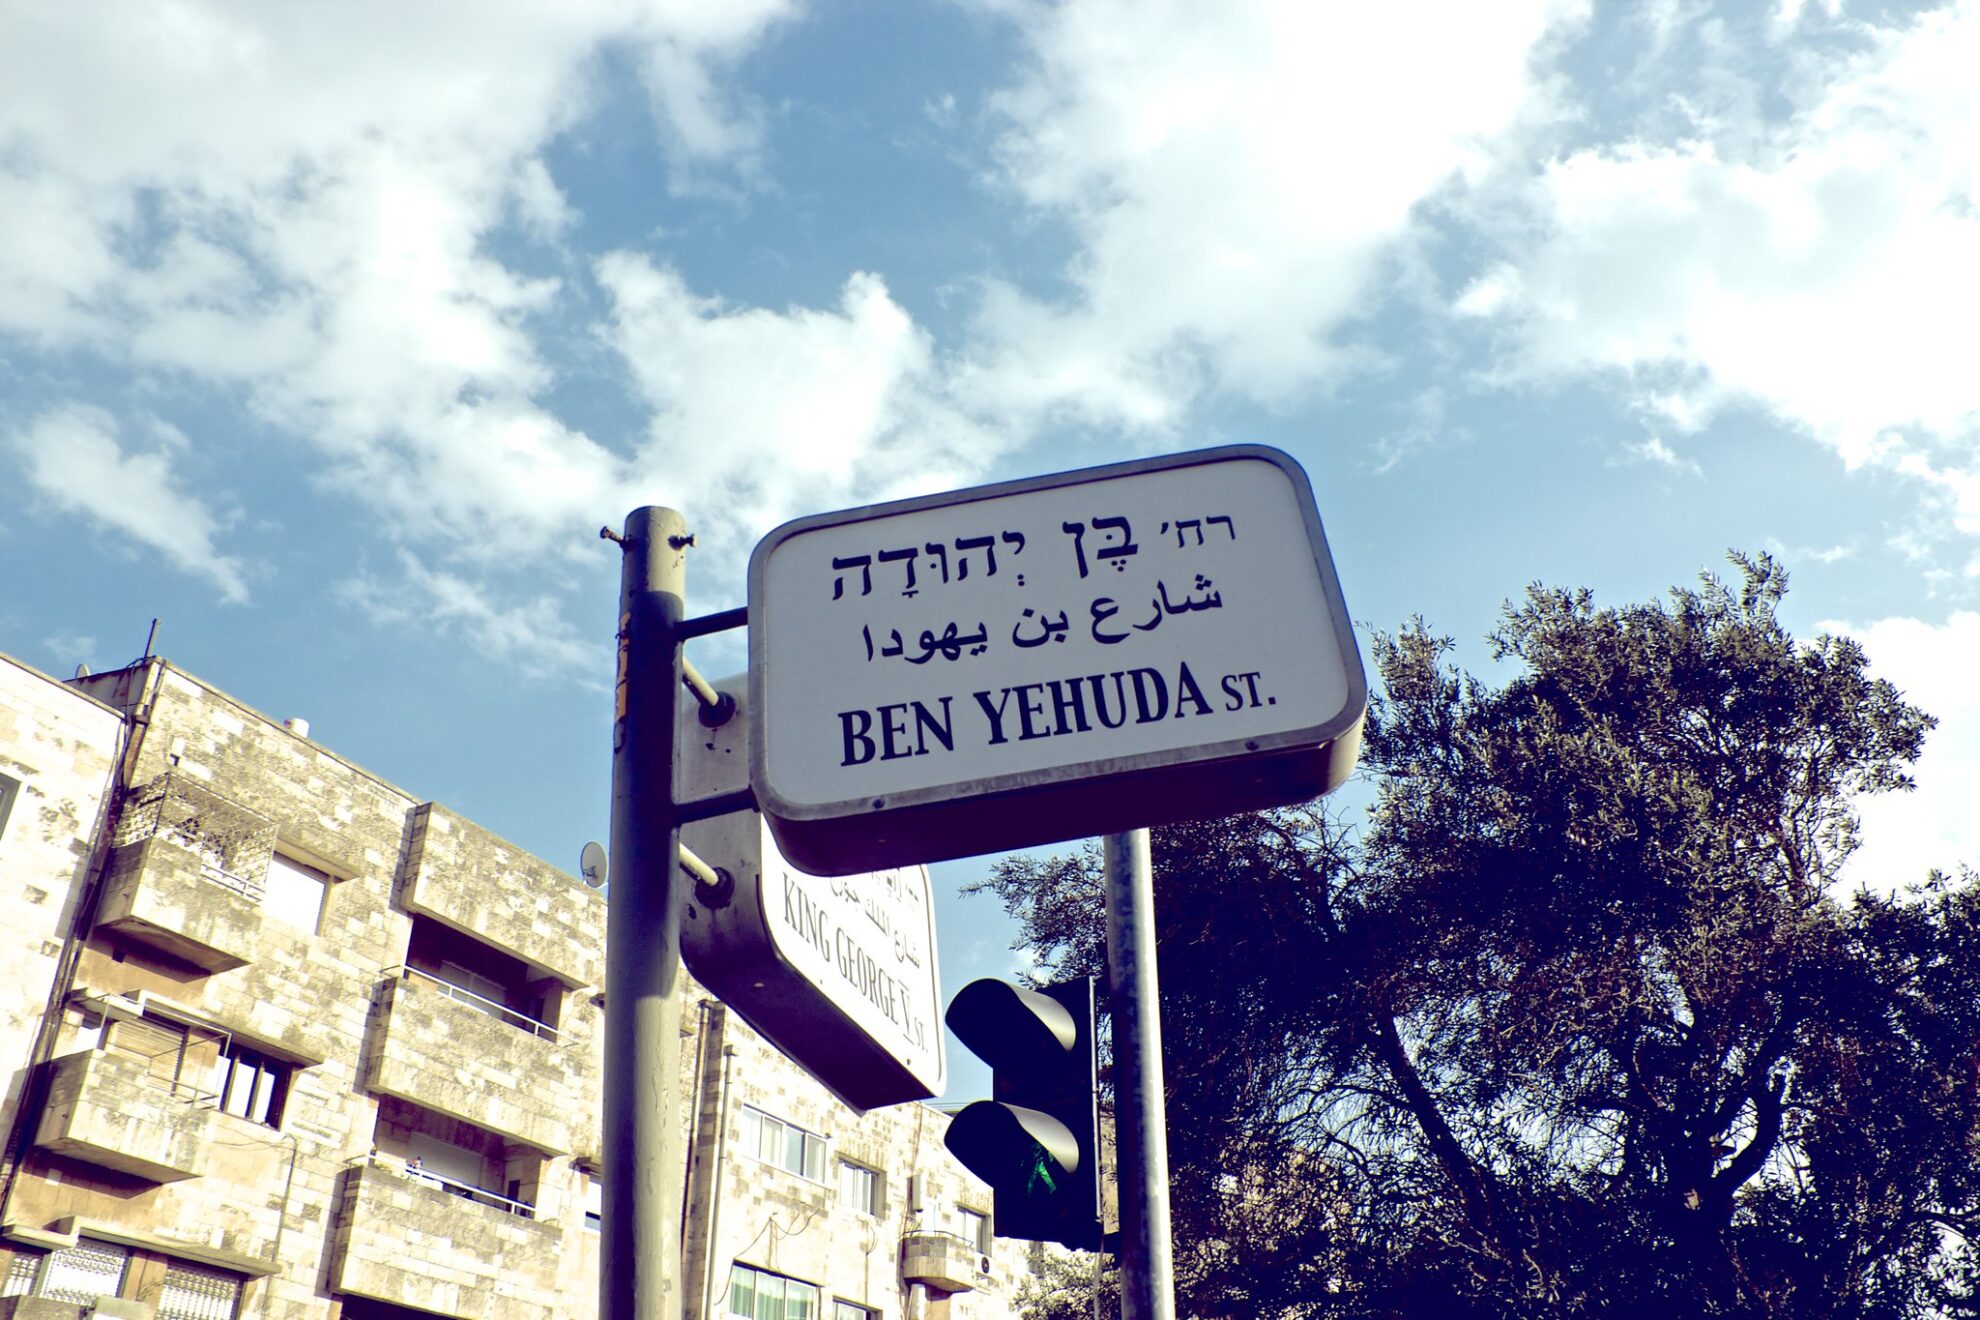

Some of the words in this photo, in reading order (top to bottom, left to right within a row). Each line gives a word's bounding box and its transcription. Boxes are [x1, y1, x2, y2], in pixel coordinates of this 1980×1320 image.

[862, 621, 989, 666] يهودا
[1011, 607, 1070, 649] بن
[1089, 573, 1223, 645] شارع
[836, 695, 955, 768] BEN
[972, 660, 1214, 746] YEHUDA
[1220, 671, 1277, 712] ST.
[782, 871, 831, 963] KING
[836, 926, 899, 1026] GEORGE
[898, 979, 916, 1046] V
